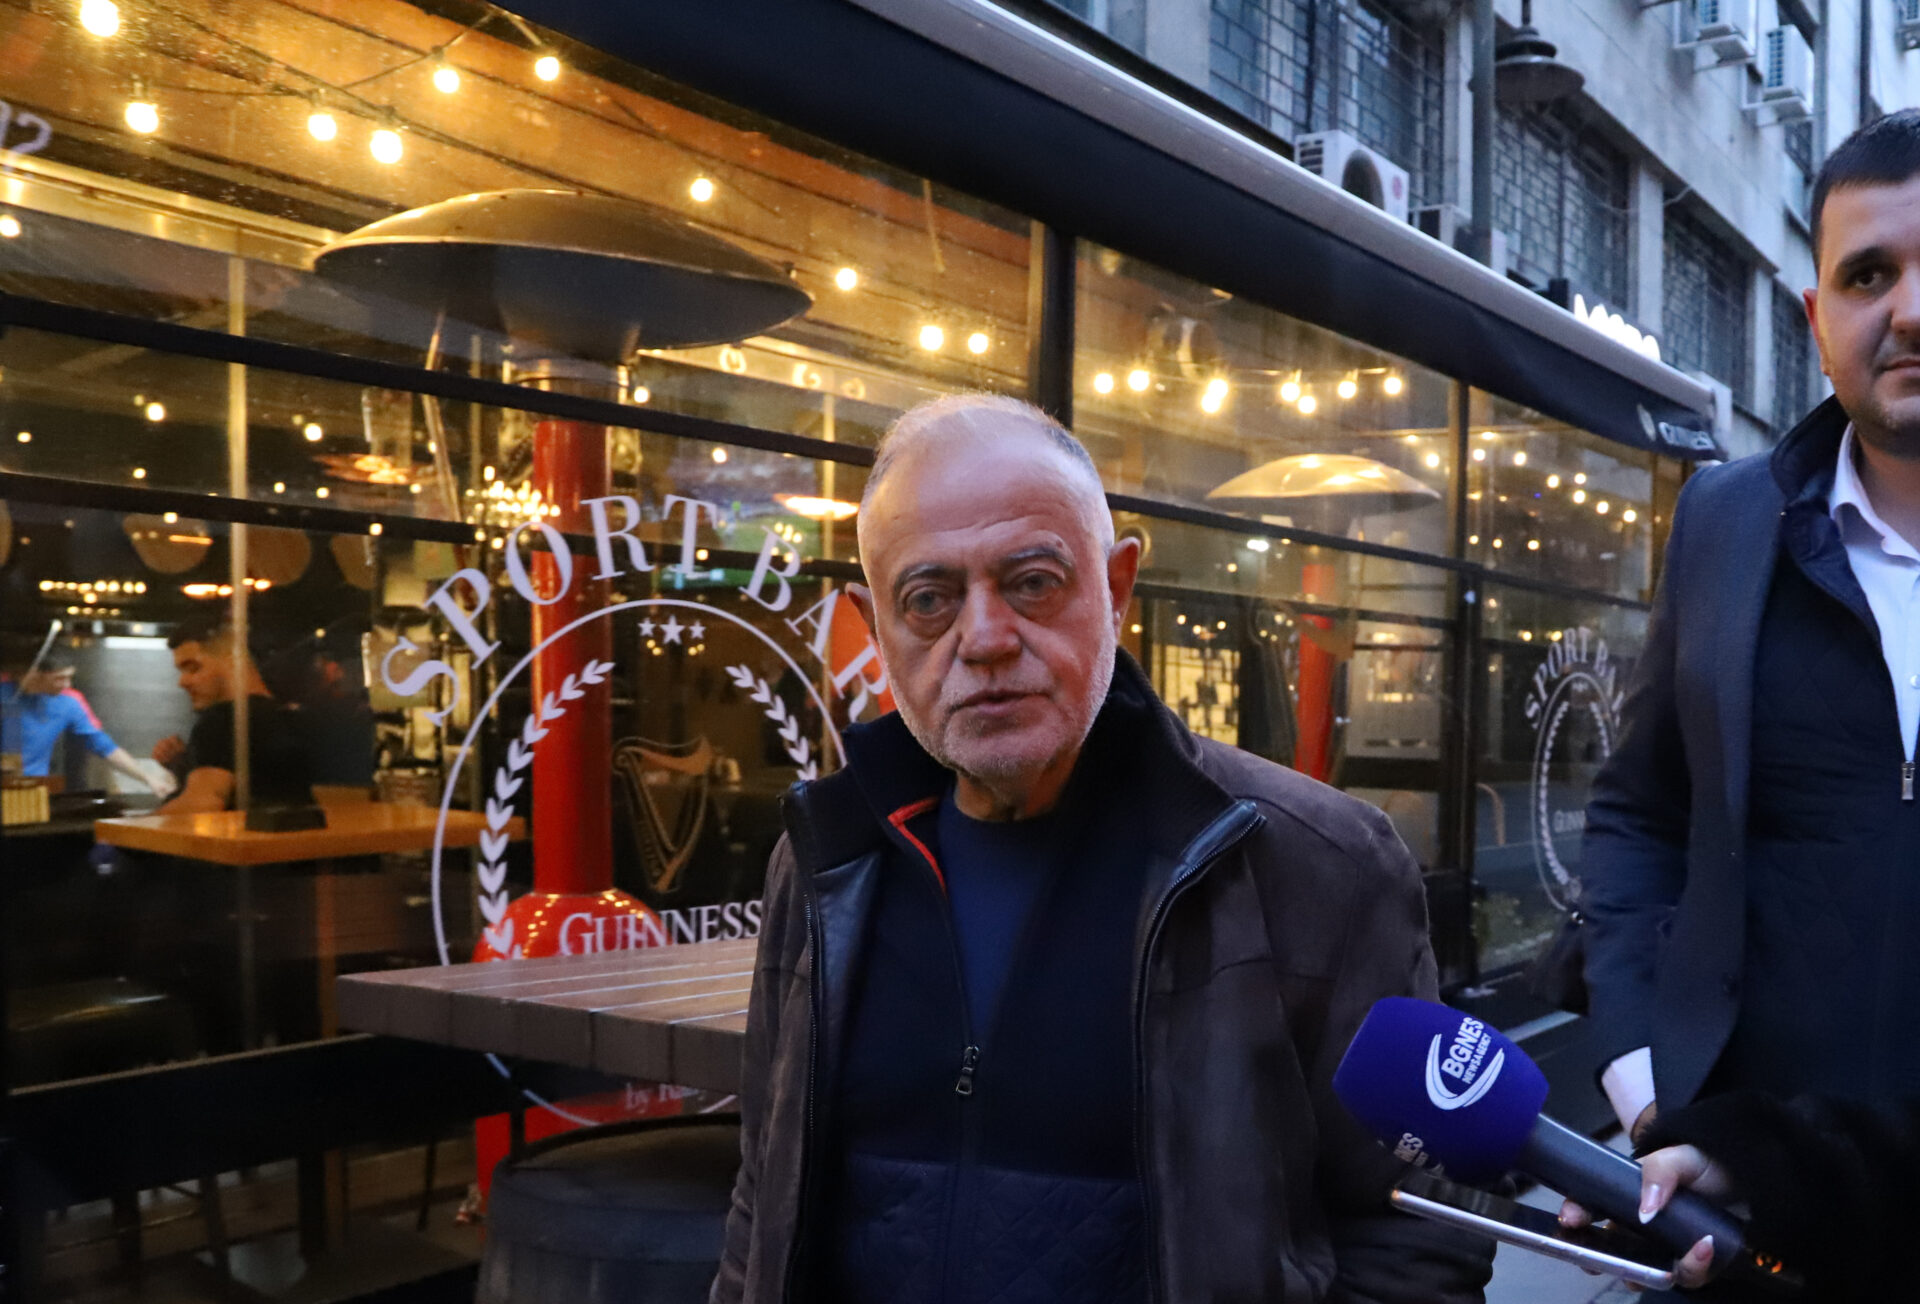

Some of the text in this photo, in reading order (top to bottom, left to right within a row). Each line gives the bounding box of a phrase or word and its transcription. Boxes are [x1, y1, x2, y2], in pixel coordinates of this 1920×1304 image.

[381, 494, 888, 726] SPORT BAR
[1525, 626, 1591, 730] SPORT
[558, 900, 763, 956] GUINNESS
[1441, 1017, 1484, 1078] BGNES
